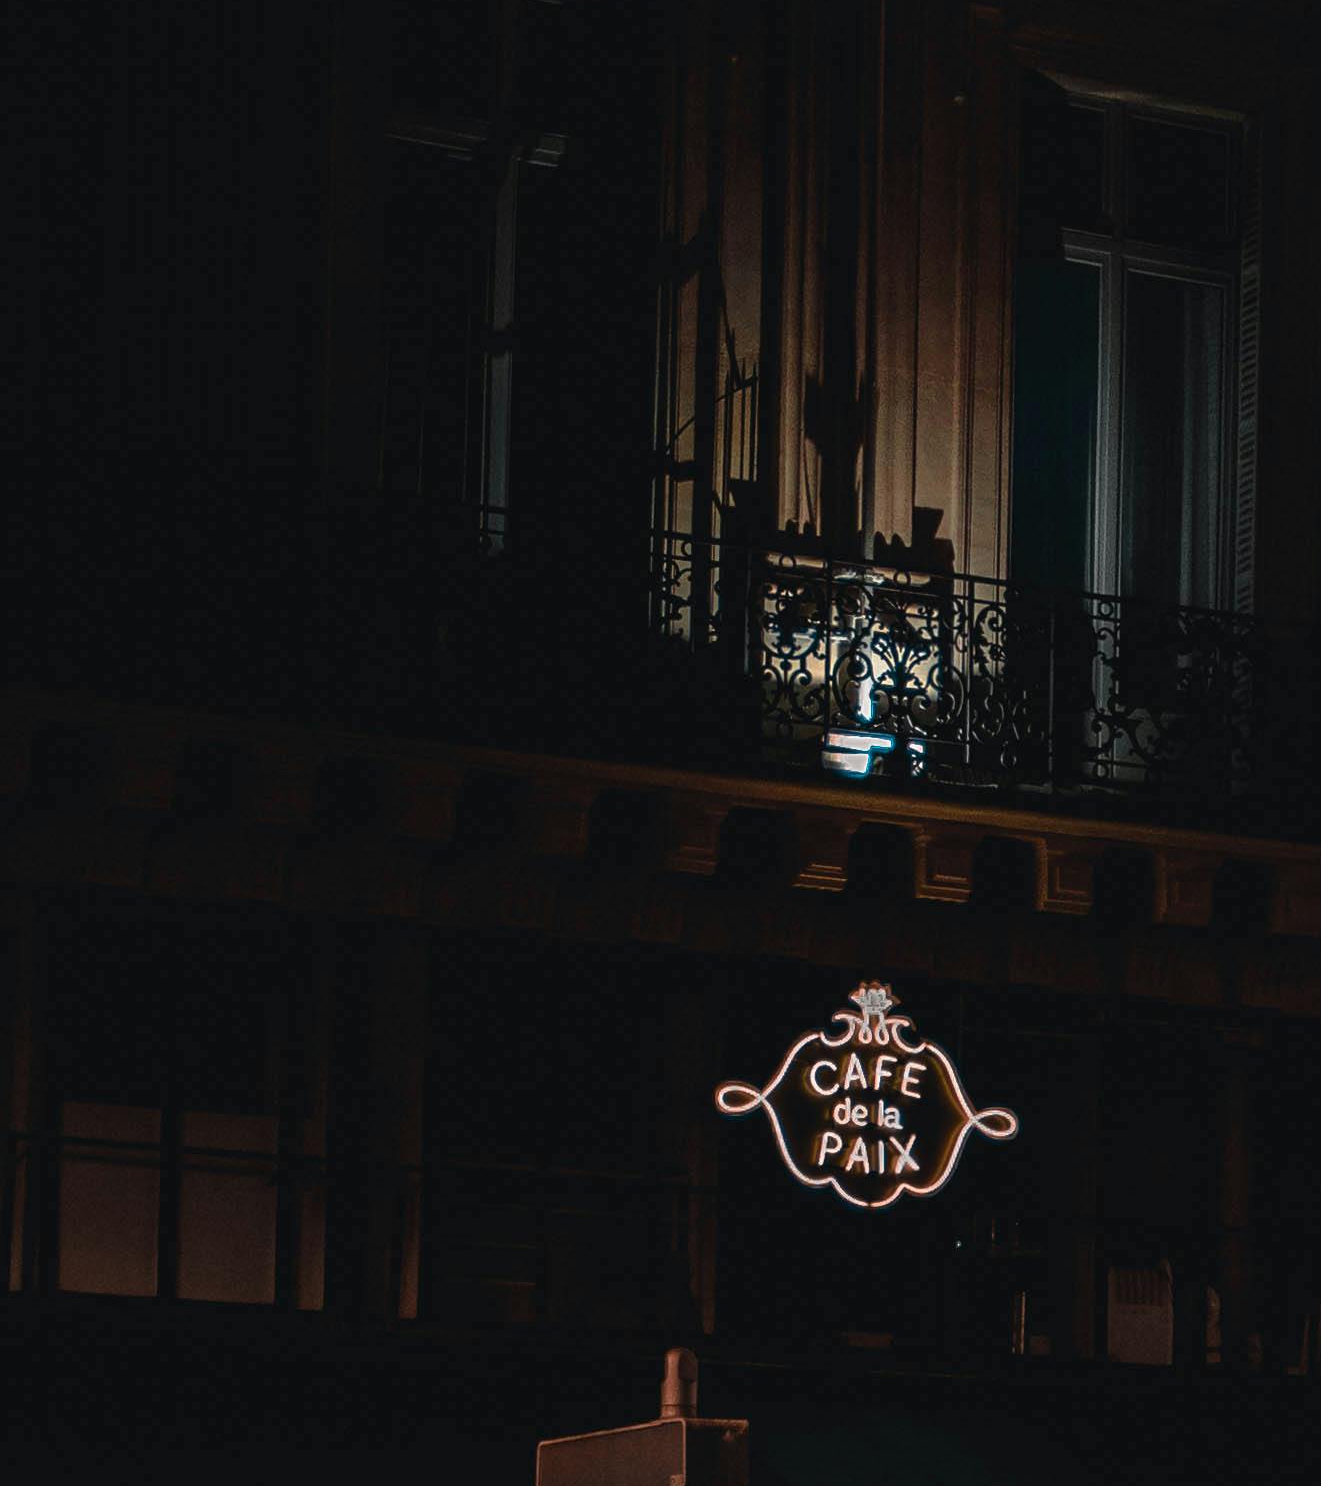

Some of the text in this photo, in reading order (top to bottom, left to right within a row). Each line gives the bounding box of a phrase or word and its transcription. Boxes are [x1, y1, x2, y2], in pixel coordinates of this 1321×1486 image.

[809, 1051, 927, 1099] CAFE
[833, 1097, 903, 1130] de la
[818, 1131, 920, 1175] PAIX
